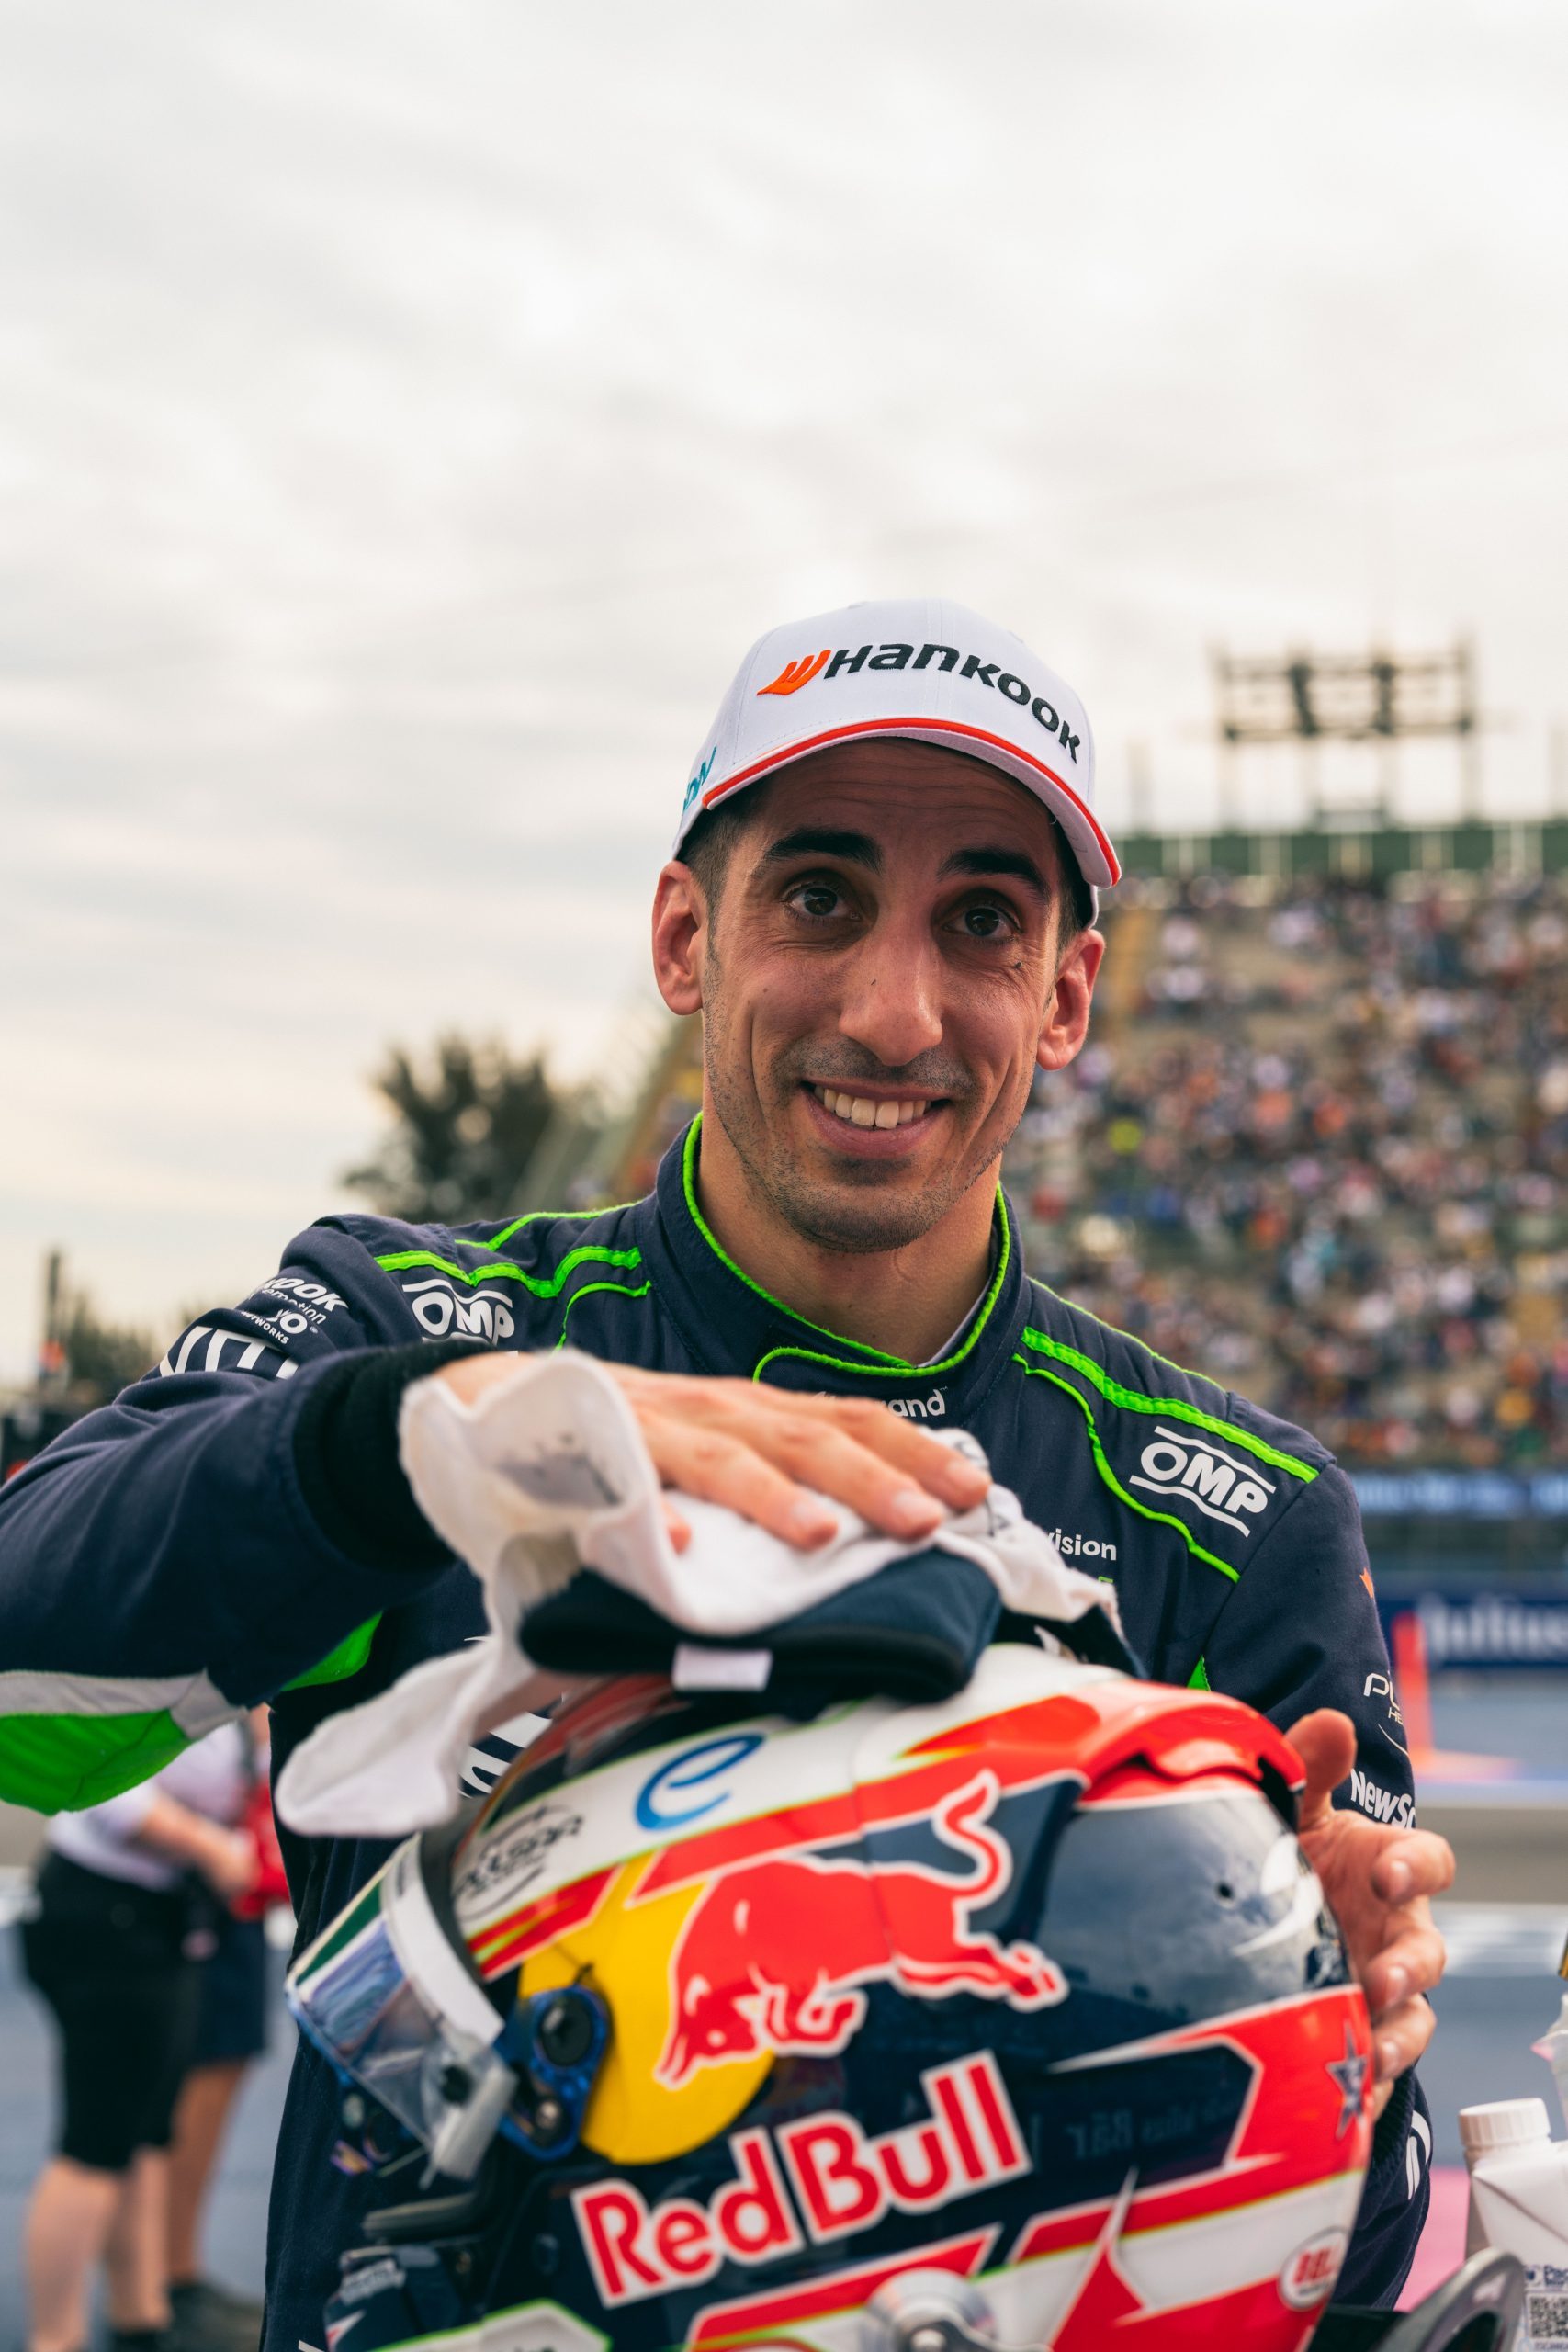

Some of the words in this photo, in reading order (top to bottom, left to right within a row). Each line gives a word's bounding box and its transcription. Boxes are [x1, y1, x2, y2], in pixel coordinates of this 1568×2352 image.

[410, 1289, 515, 1347] OMP
[1139, 1439, 1269, 1516] OMP
[577, 2132, 797, 2302] Red
[783, 2055, 1026, 2239] Bull
